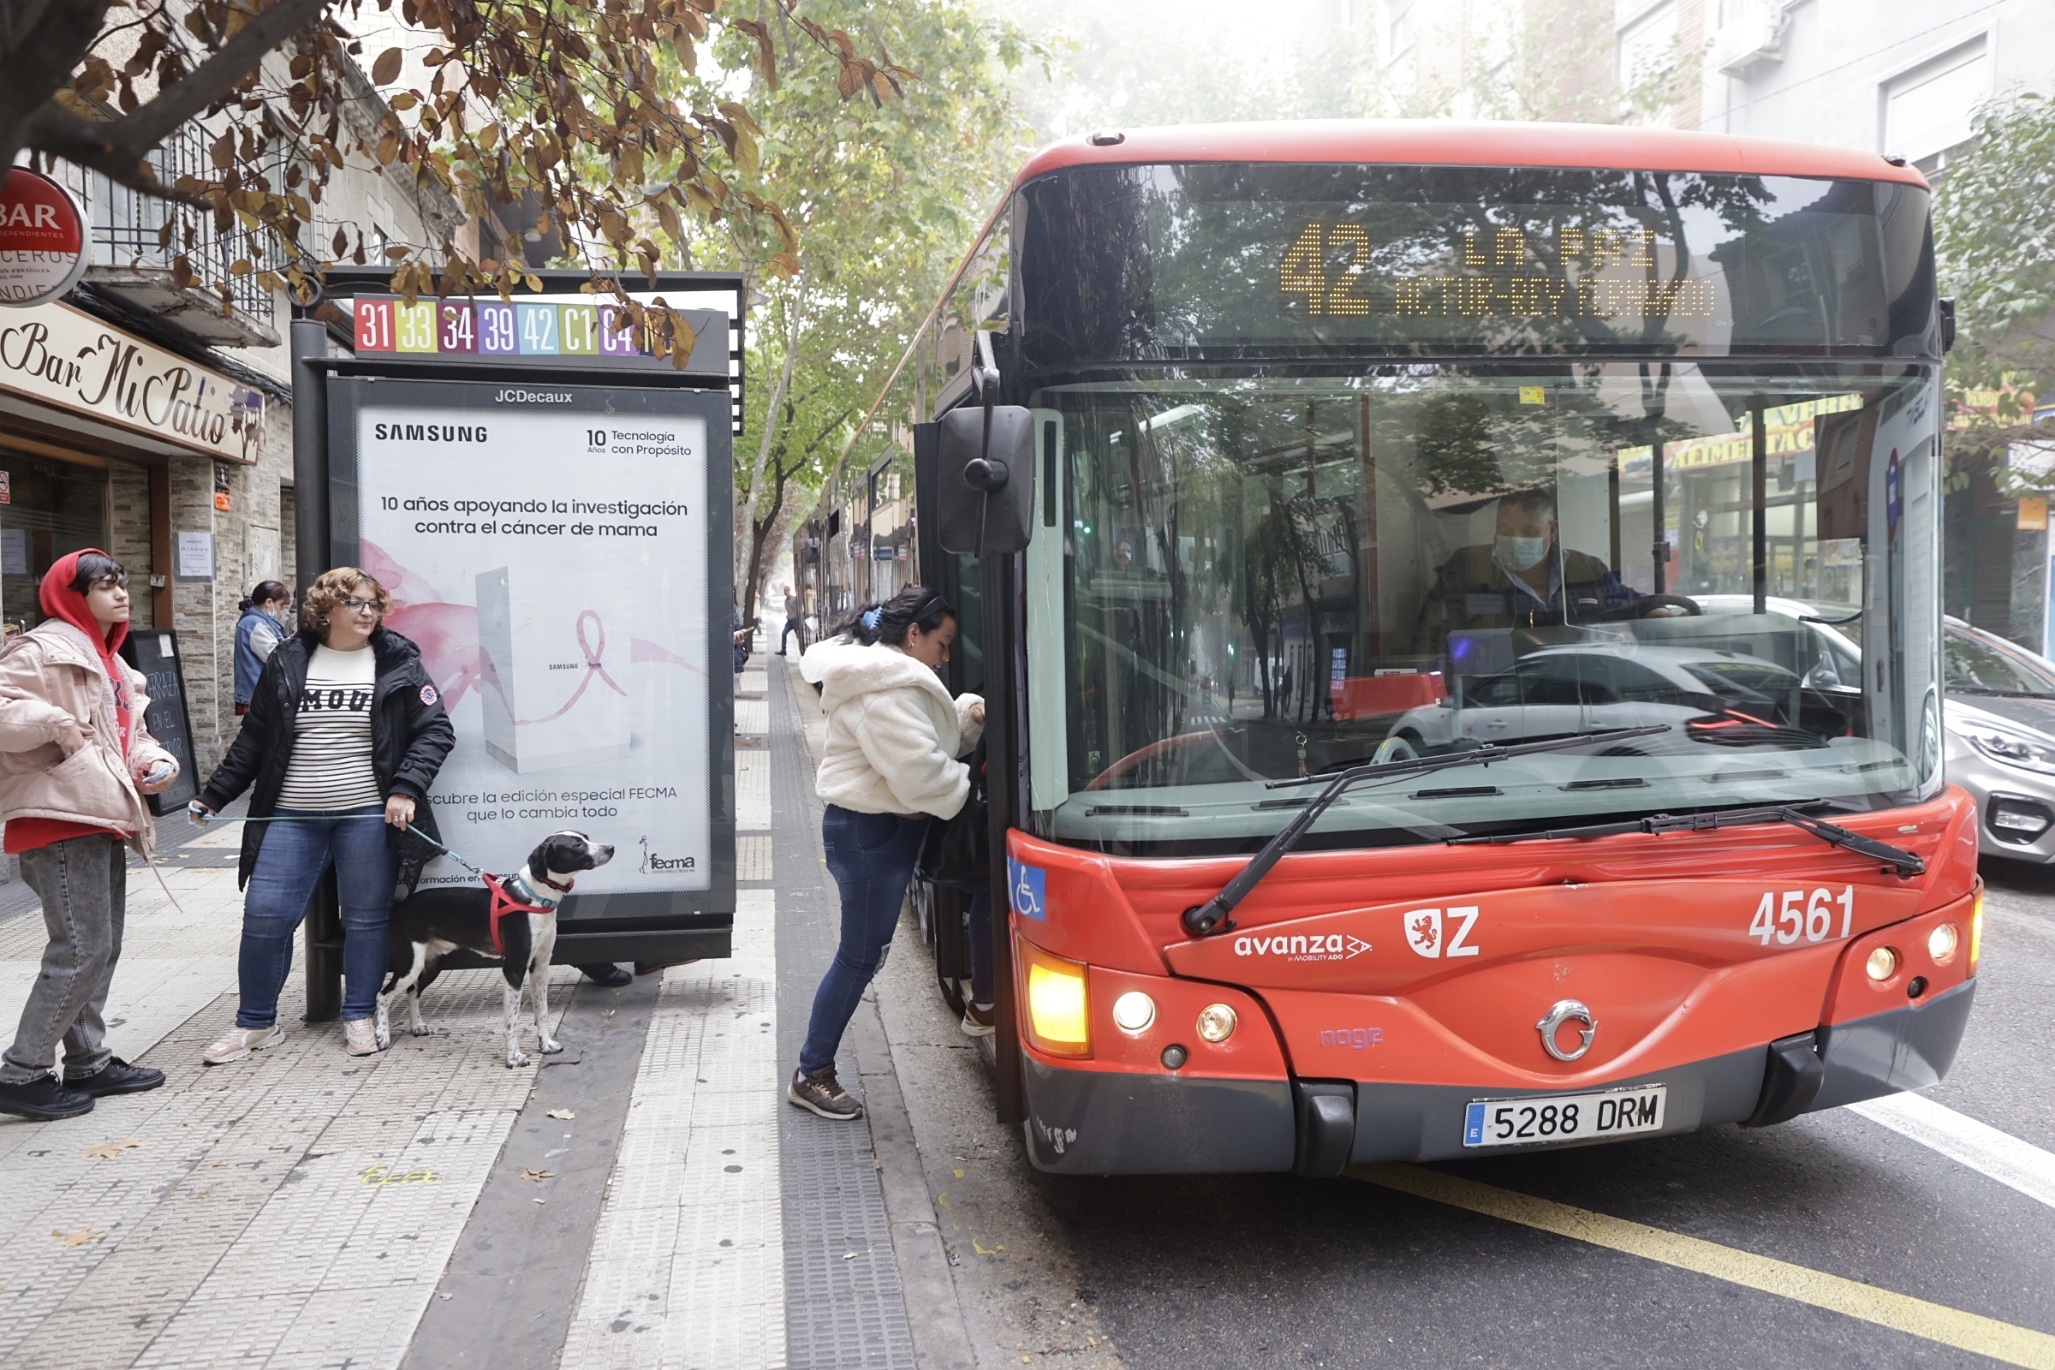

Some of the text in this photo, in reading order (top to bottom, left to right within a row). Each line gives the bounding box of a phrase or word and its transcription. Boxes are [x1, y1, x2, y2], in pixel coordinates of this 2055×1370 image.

[1465, 226, 1524, 265] LA
[1280, 223, 1369, 315] 42
[361, 304, 390, 348] 31
[402, 305, 432, 349] 33
[443, 307, 474, 350] 34
[484, 308, 515, 351] 39
[524, 309, 554, 350] 42
[565, 308, 592, 351] C1
[603, 309, 633, 352] C4
[0, 322, 227, 445] Bar Mi Patio
[495, 390, 572, 403] JCDecaux
[375, 423, 487, 443] SAMSUNG
[587, 430, 606, 446] 10
[611, 430, 675, 444] Tecnología
[611, 445, 692, 457] con Propósito
[381, 496, 688, 518] 10 años apoyando la investigación
[414, 519, 657, 537] contra el cáncer de mama
[483, 792, 496, 803] la
[501, 788, 557, 803] edición
[561, 788, 626, 803] especial
[629, 787, 677, 800] FECMA
[466, 806, 618, 824] que lo cambia todo
[650, 853, 695, 869] fecma
[1748, 885, 1854, 946] 4561
[1446, 905, 1479, 958] Z
[1234, 934, 1344, 956] avanza
[1294, 954, 1327, 962] MOBILITY
[1319, 1027, 1384, 1051] noge
[1470, 1094, 1659, 1139] E 5288 DRM
